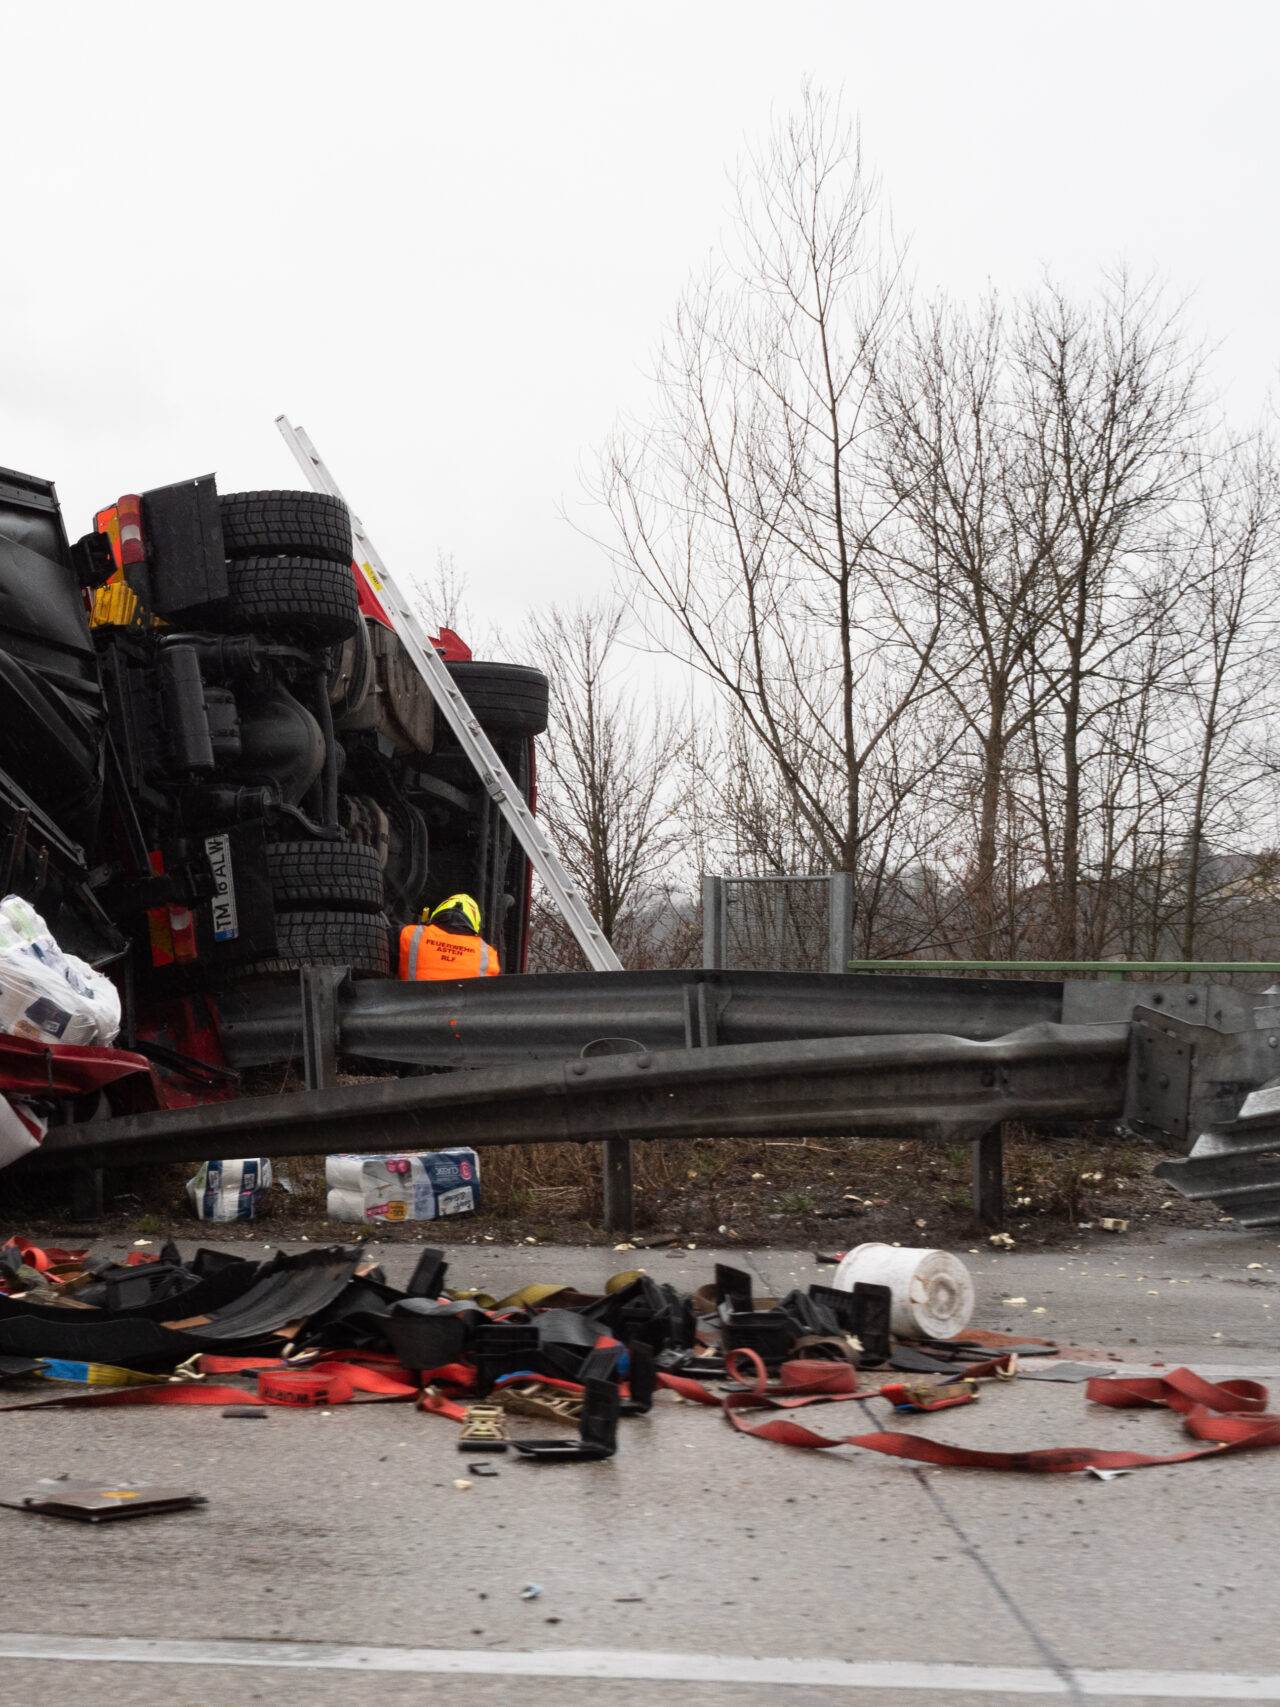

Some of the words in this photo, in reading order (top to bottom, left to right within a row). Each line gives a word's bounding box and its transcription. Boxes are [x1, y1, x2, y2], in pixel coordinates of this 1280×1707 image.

[207, 839, 227, 878] ALW
[214, 902, 232, 930] TM
[426, 939, 476, 954] FEUERWEHR
[436, 946, 463, 957] ASTEN
